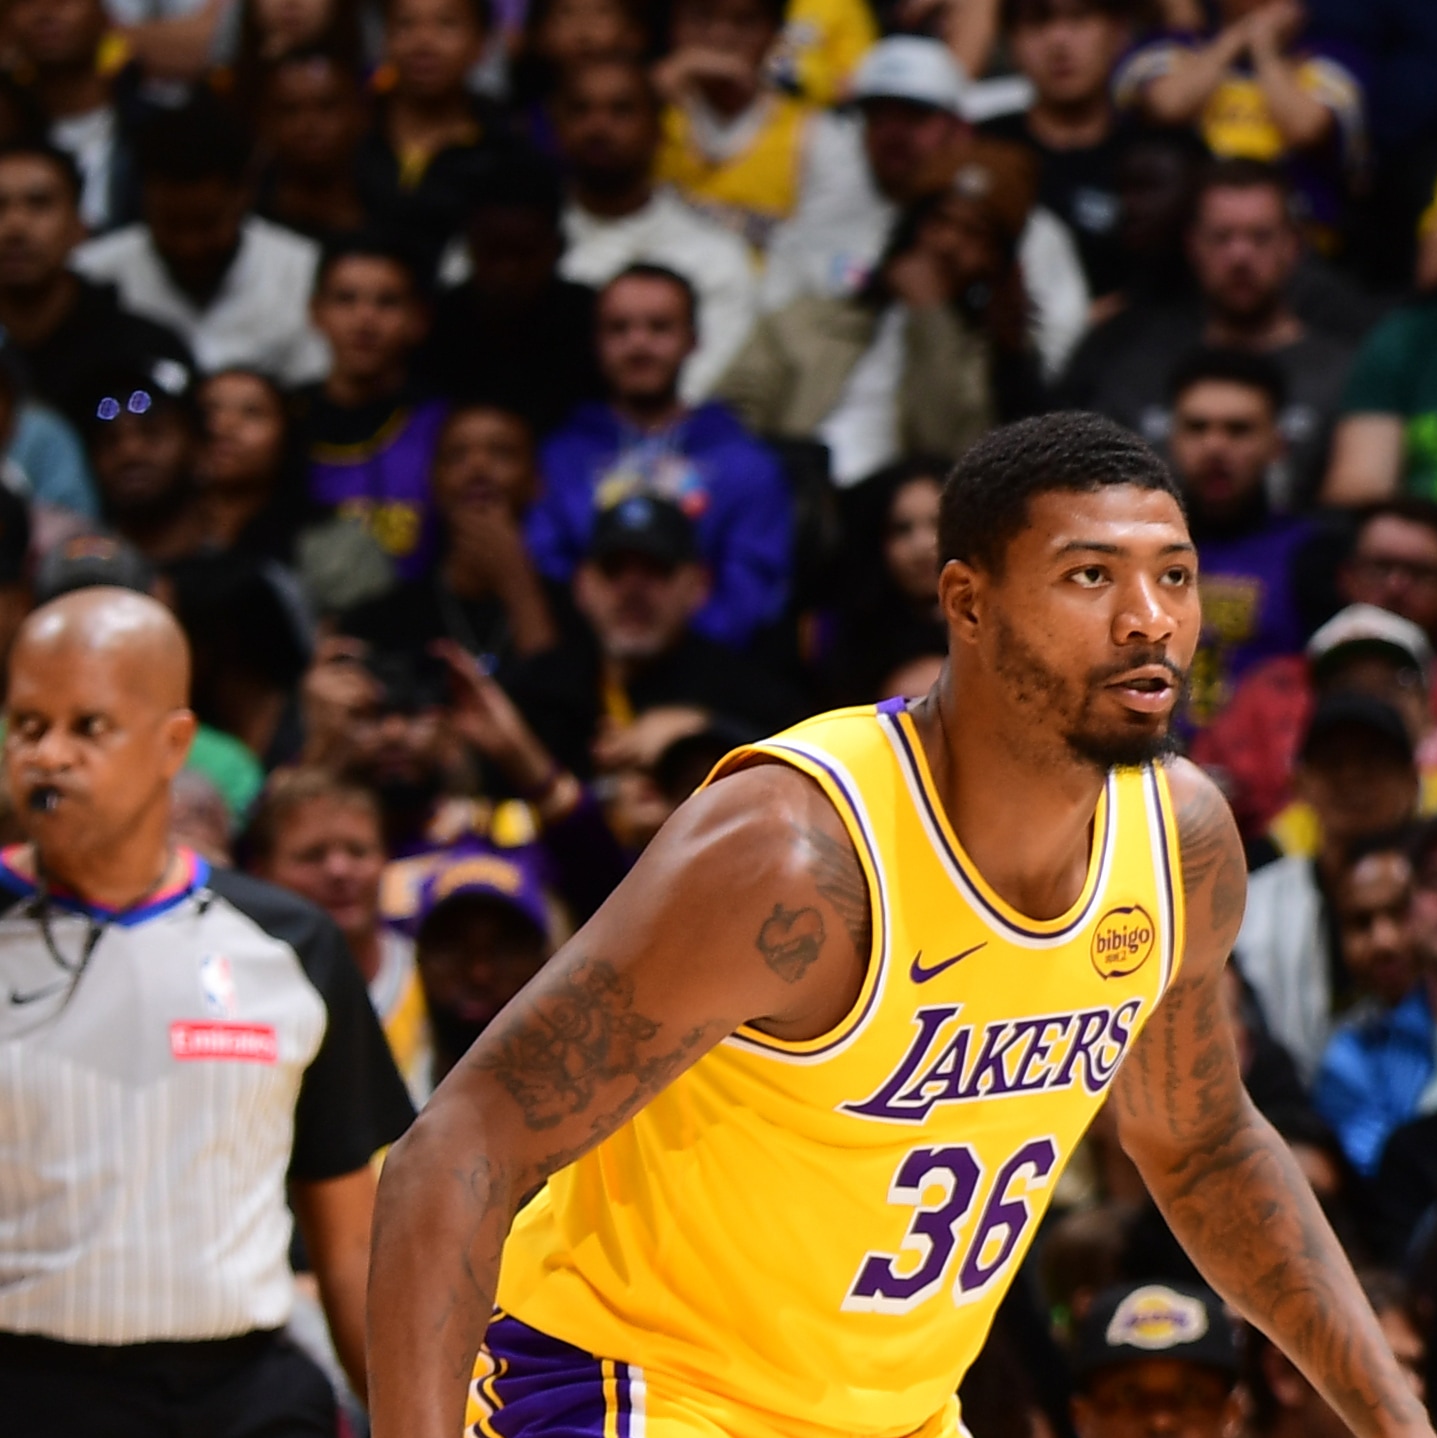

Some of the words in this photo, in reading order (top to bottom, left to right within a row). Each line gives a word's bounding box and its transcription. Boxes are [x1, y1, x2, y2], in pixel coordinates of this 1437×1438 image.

[1096, 925, 1150, 954] bibigo
[835, 997, 1145, 1124] LAKERS
[840, 1133, 1058, 1315] 36
